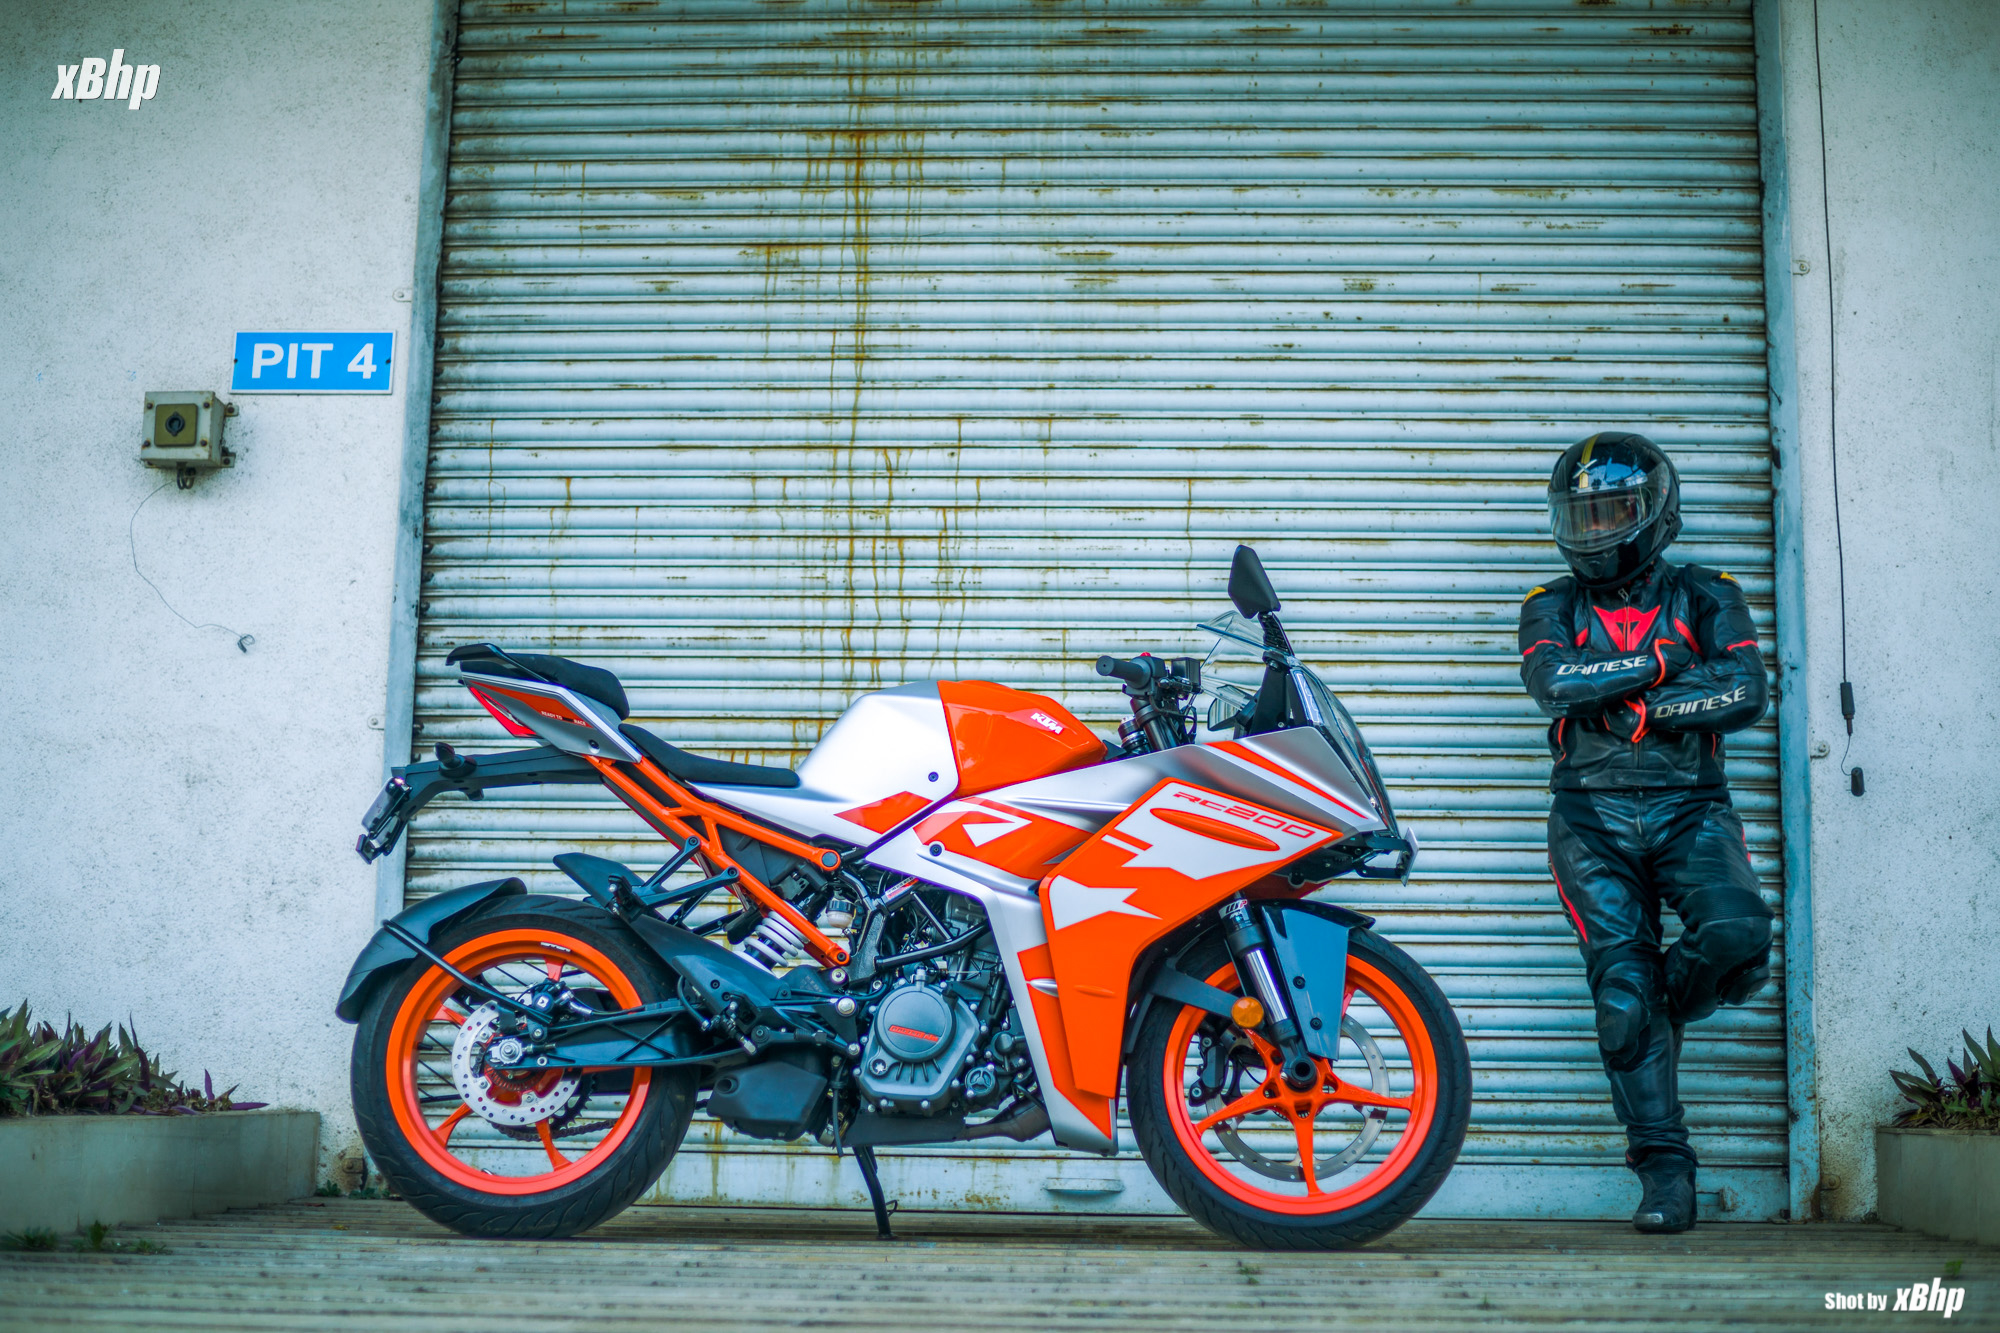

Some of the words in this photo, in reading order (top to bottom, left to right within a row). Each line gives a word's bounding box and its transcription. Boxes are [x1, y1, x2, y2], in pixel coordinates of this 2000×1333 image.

[251, 343, 333, 379] PIT
[347, 343, 377, 379] 4
[1557, 655, 1648, 676] DAINESE
[1654, 686, 1746, 719] DAINESE
[1030, 712, 1063, 735] KTM
[1173, 791, 1316, 839] RC200
